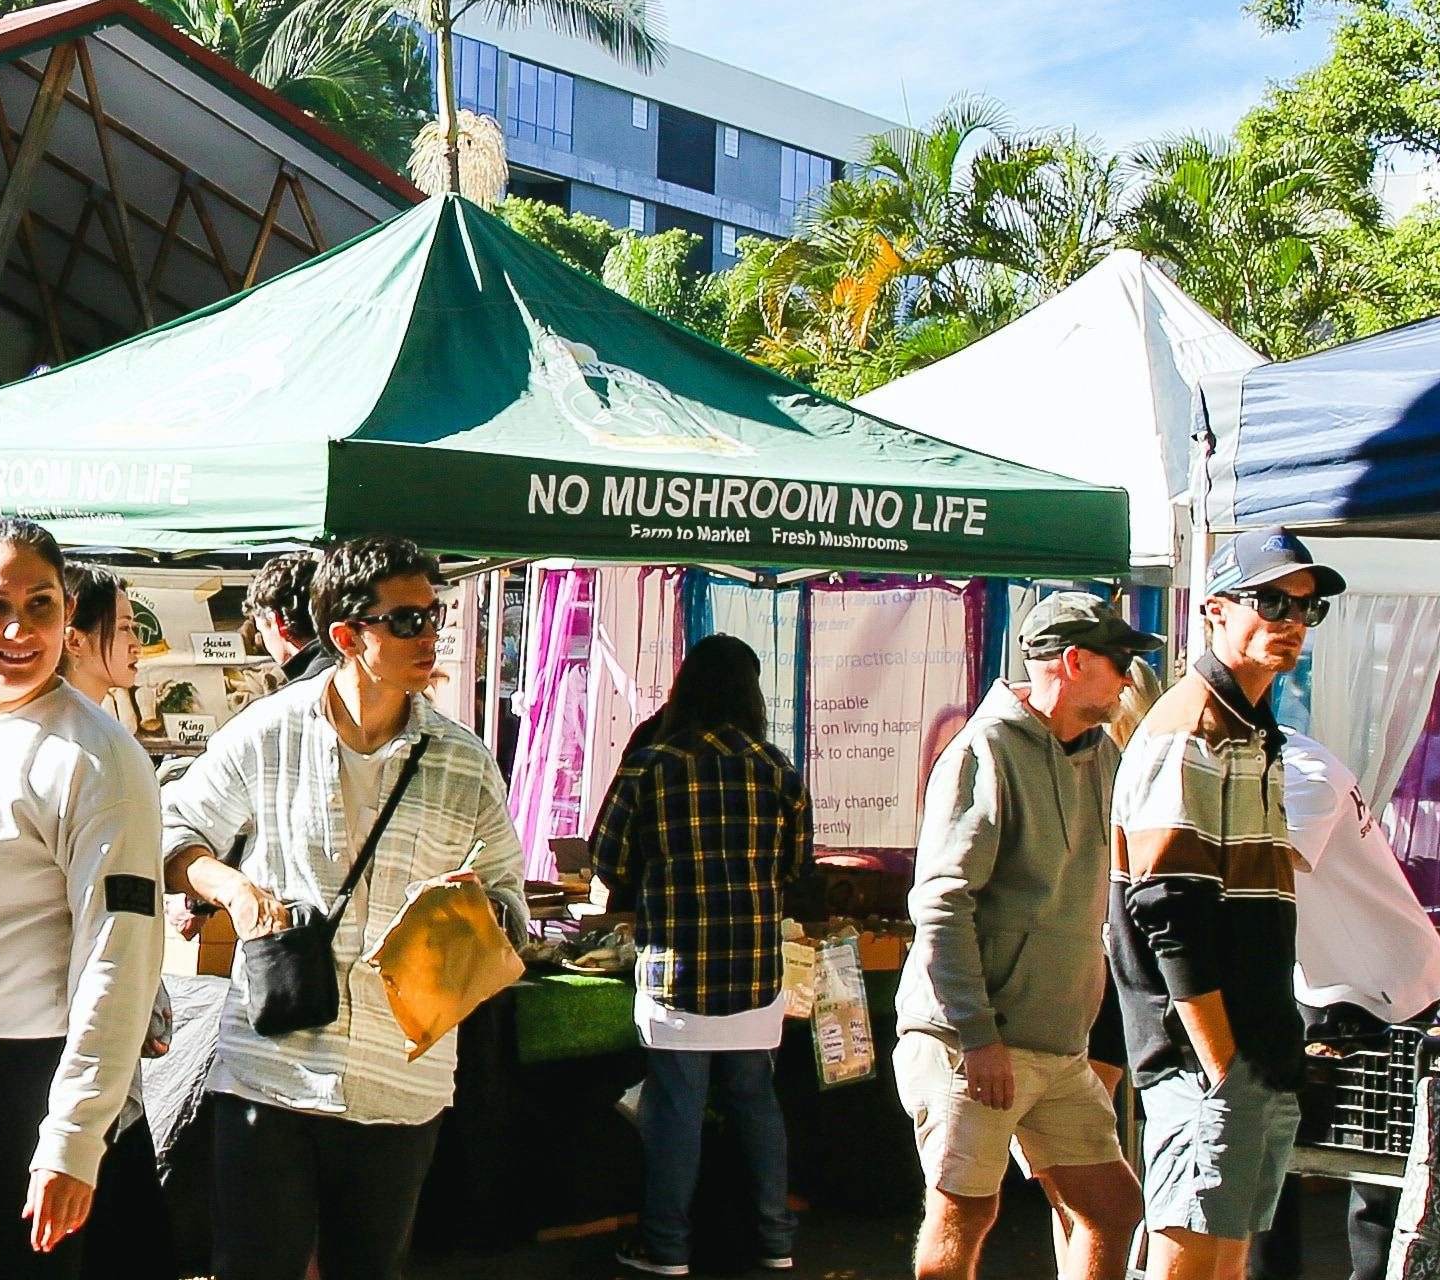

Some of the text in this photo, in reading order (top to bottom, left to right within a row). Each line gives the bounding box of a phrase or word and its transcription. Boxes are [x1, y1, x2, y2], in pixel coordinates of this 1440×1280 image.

[77, 461, 121, 502] NO
[126, 463, 193, 506] LIFE
[527, 473, 987, 536] NO MUSHROOM NO LIFE
[629, 523, 751, 544] Farm to Market
[771, 526, 909, 552] Fresh Mushrooms
[834, 649, 906, 669] practical
[813, 696, 869, 713] capable
[178, 719, 205, 734] King
[821, 725, 839, 735] on
[844, 721, 879, 736] living
[829, 748, 842, 759] to
[846, 745, 896, 762] change
[815, 794, 899, 812] cally changed
[813, 820, 851, 836] erently
